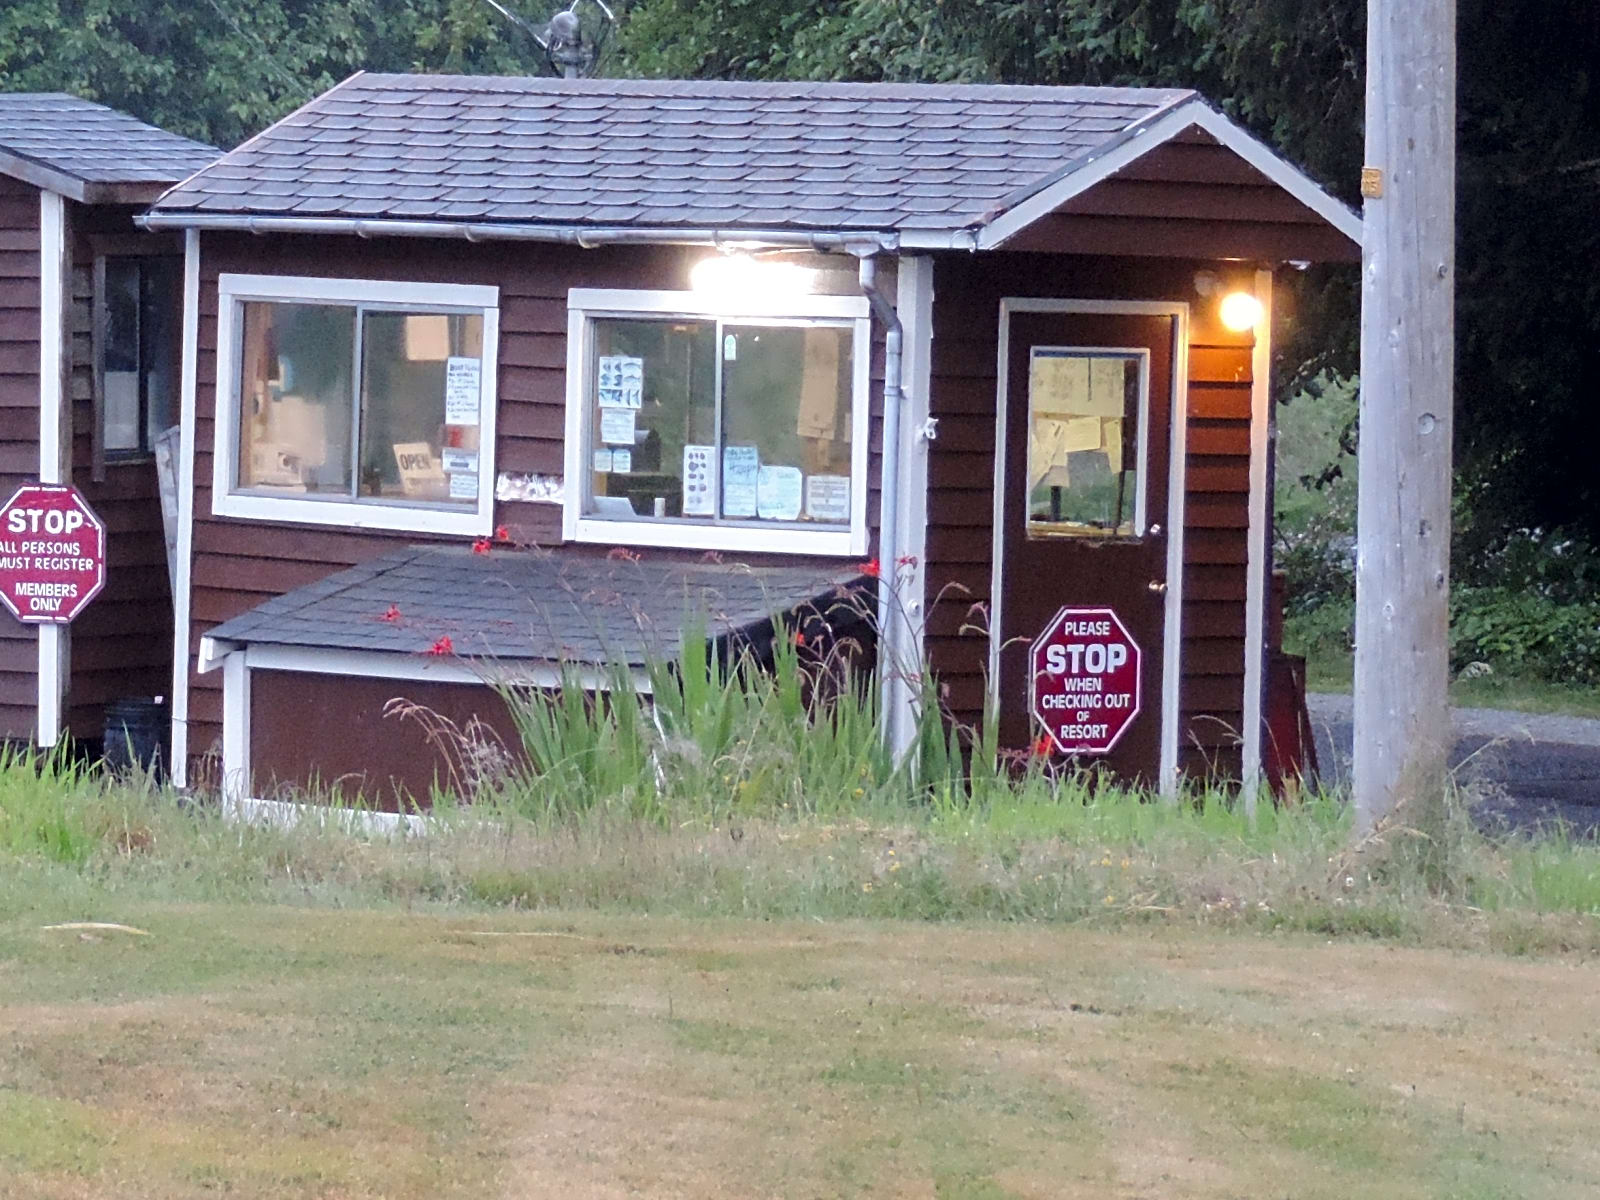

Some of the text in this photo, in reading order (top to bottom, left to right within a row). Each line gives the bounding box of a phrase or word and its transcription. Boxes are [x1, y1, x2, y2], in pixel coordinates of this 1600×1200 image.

[400, 453, 432, 471] OPEN
[7, 508, 84, 535] STOP
[21, 541, 81, 556] PERSONS
[34, 558, 95, 571] REGISTER
[15, 582, 78, 597] MEMBERS
[30, 597, 63, 611] ONLY
[1064, 621, 1111, 636] PLEASE
[1046, 643, 1127, 674] STOP
[1064, 677, 1103, 692] WHEN
[1041, 693, 1131, 708] CHECKING OUT
[1076, 710, 1091, 723] OF
[1060, 724, 1109, 739] RESORT
